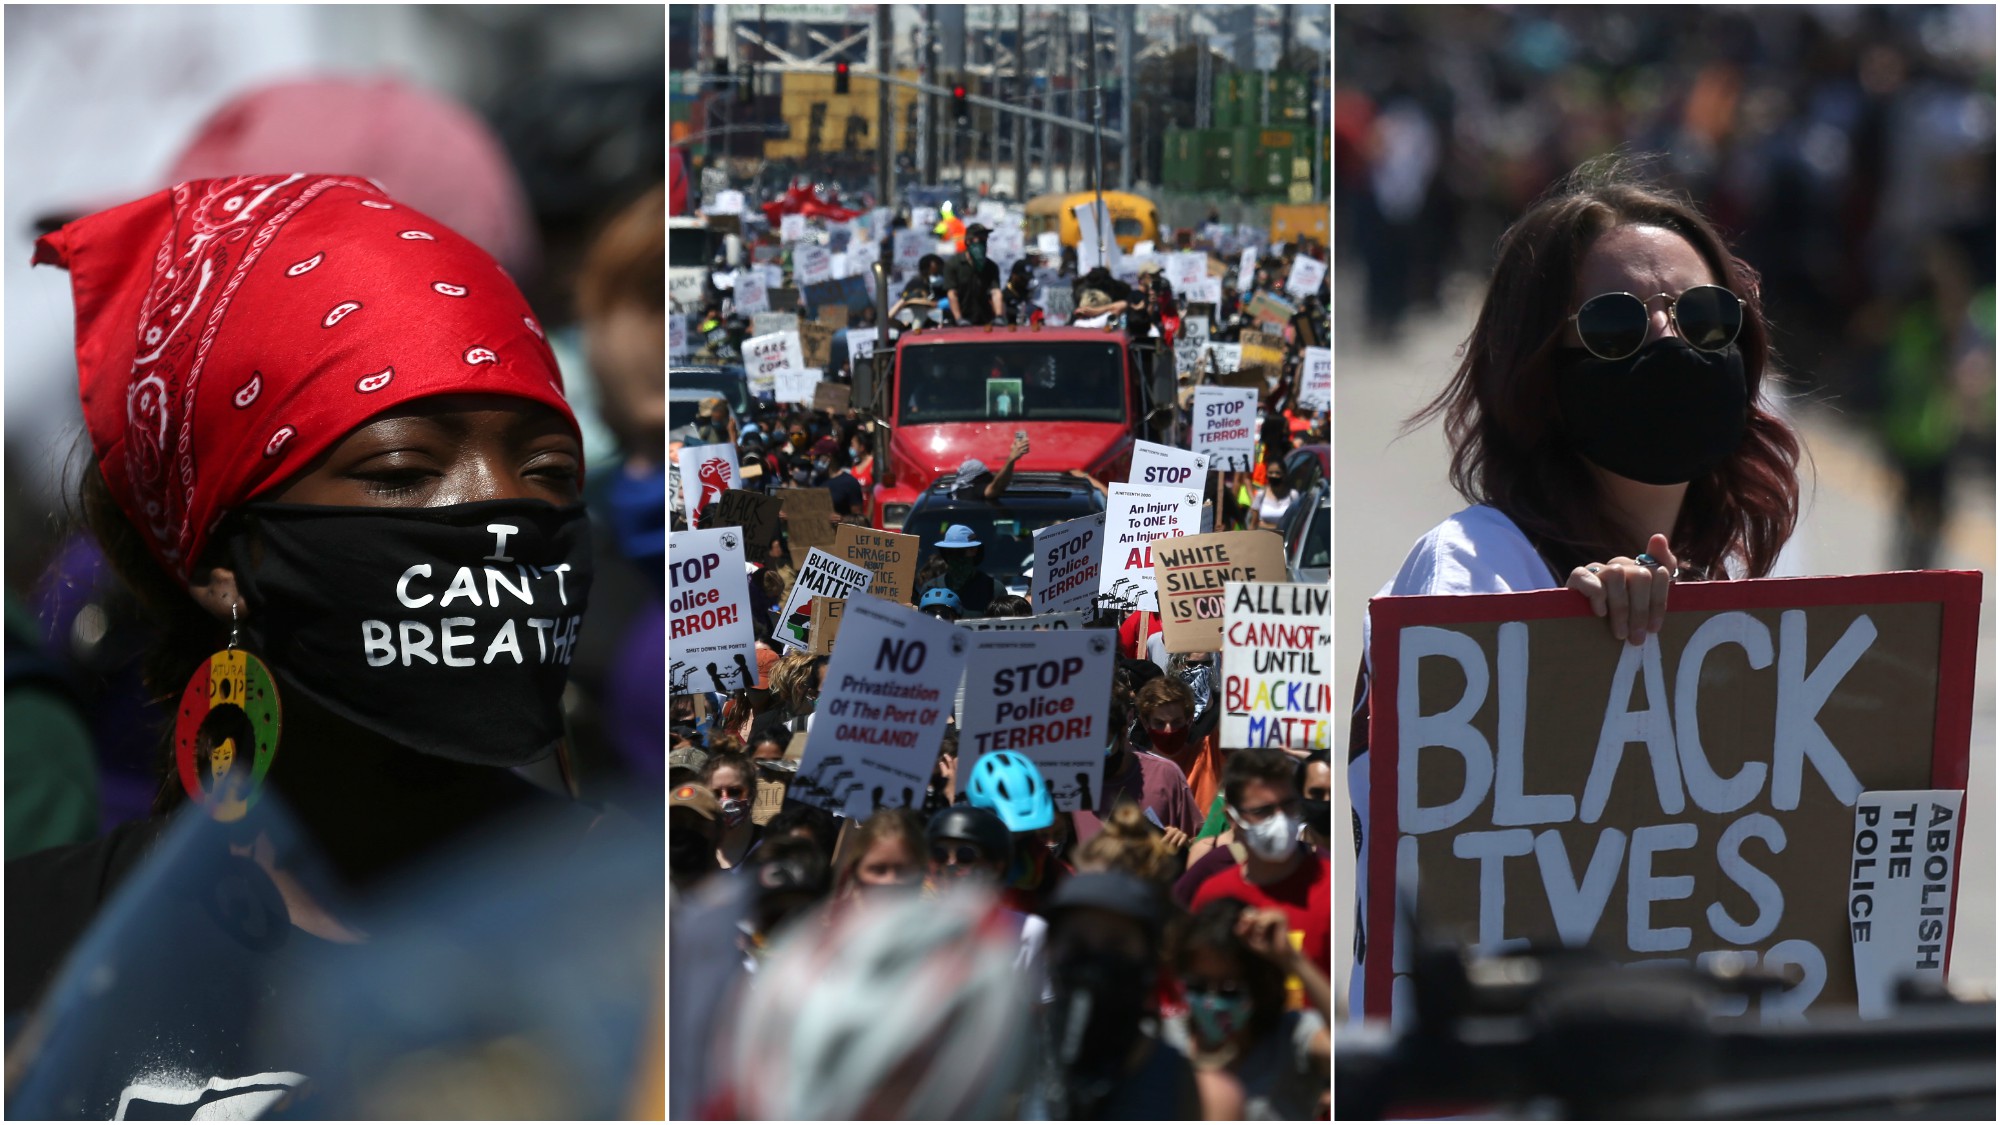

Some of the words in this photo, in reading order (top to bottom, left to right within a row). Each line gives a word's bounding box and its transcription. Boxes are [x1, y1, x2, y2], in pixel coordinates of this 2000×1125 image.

[754, 341, 787, 356] CARE
[1313, 361, 1331, 370] ST
[1206, 400, 1244, 417] STOP
[1199, 428, 1249, 443] TERROR!
[1208, 418, 1241, 430] Police
[1144, 466, 1192, 484] STOP
[1129, 504, 1144, 514] An
[1147, 502, 1179, 515] Injury
[1129, 518, 1141, 528] To
[1143, 516, 1166, 527] ONE
[1169, 515, 1178, 525] Is
[483, 524, 519, 562] I
[856, 535, 870, 545] LET
[885, 539, 894, 547] BE
[1048, 530, 1093, 566] STOP
[1119, 533, 1134, 543] An
[1137, 530, 1168, 543] Injury
[1172, 528, 1184, 538] To
[848, 546, 900, 563] ENRAGED
[864, 561, 884, 570] ABOUT
[1125, 546, 1154, 570] AL
[1160, 544, 1230, 568] WHITE
[669, 553, 720, 588] TOP
[799, 567, 861, 599] MATTE
[808, 553, 842, 577] BLACK
[840, 567, 868, 588] LIVES
[1039, 562, 1098, 604] TERROR!
[1049, 555, 1089, 583] Police
[1166, 567, 1256, 592] SILENCE
[396, 563, 571, 609] CAN'T
[1233, 584, 1285, 615] ALL
[1291, 588, 1331, 616] LIV
[669, 588, 719, 613] olice
[1170, 600, 1192, 618] IS
[669, 603, 738, 640] RROR!
[1228, 621, 1320, 650] CANNOT
[1319, 634, 1331, 646] MA
[362, 615, 581, 667] BREATHE
[874, 637, 927, 674] NO
[1254, 650, 1321, 675] UNTIL
[204, 677, 255, 701] DOPE
[841, 675, 940, 701] Privatization
[993, 656, 1084, 696] STOP
[1226, 675, 1302, 713] BLACK
[829, 698, 850, 716] Of
[853, 702, 880, 720] The
[883, 705, 917, 725] Port
[920, 708, 940, 726] Of
[996, 696, 1075, 725] Police
[1397, 609, 1878, 835] BLACK
[835, 724, 919, 748] OAKLAND!
[974, 715, 1093, 755] TERROR!
[1248, 716, 1331, 748] MATTE
[1888, 803, 1918, 879] THE
[1851, 806, 1880, 943] POLICE
[1916, 803, 1953, 969] ABOLISH
